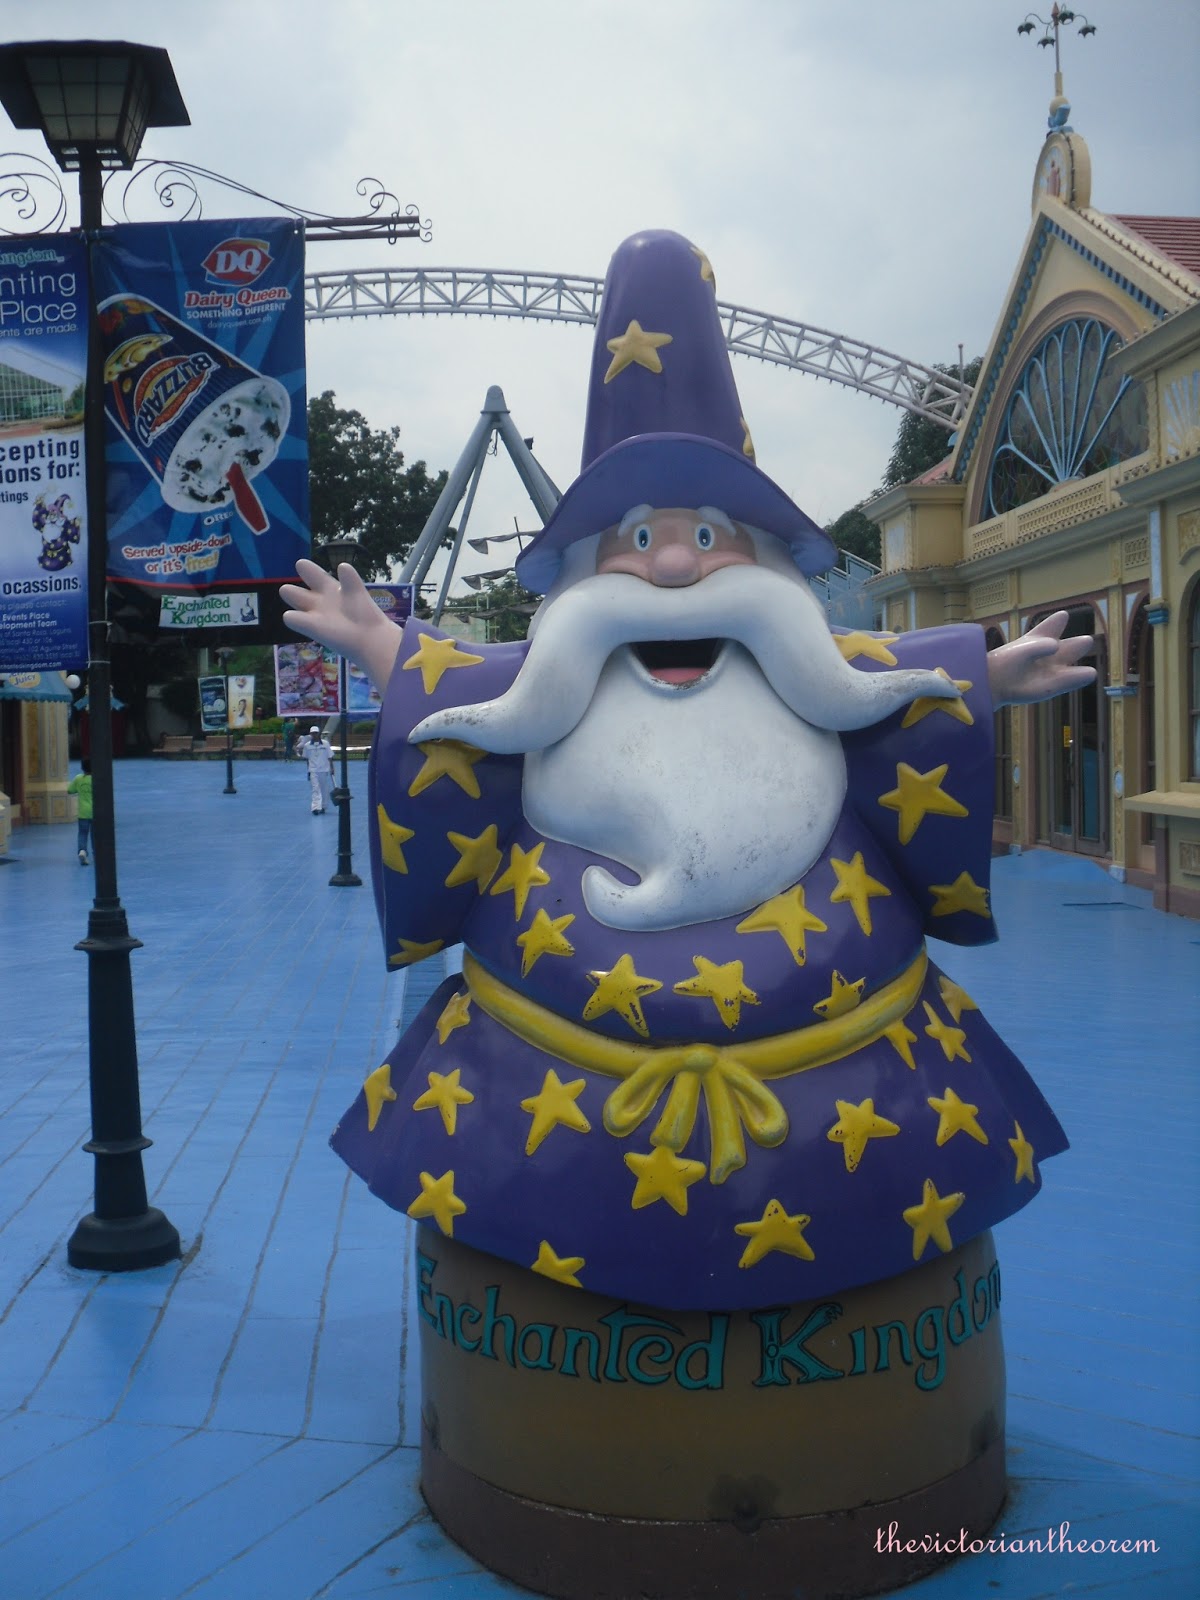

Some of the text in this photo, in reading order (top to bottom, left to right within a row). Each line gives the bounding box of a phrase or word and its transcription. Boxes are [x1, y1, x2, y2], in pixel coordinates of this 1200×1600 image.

[0, 248, 57, 267] ingdom
[215, 249, 262, 275] DQ
[0, 270, 76, 297] nting
[184, 287, 288, 309] Dairy Queen
[0, 300, 77, 325] Place
[187, 303, 286, 319] SOMETHING DIFFERENT
[24, 326, 43, 335] are
[48, 460, 80, 479] for:
[204, 511, 233, 525] OREO
[123, 534, 231, 559] Served upside-down
[146, 551, 219, 574] or it's free!
[3, 576, 81, 595] ocassions.
[162, 595, 230, 611] Enchanted
[3, 612, 50, 622] Events Place
[170, 611, 231, 627] Kingdom
[417, 1250, 1000, 1392] Enchanted Kingdom
